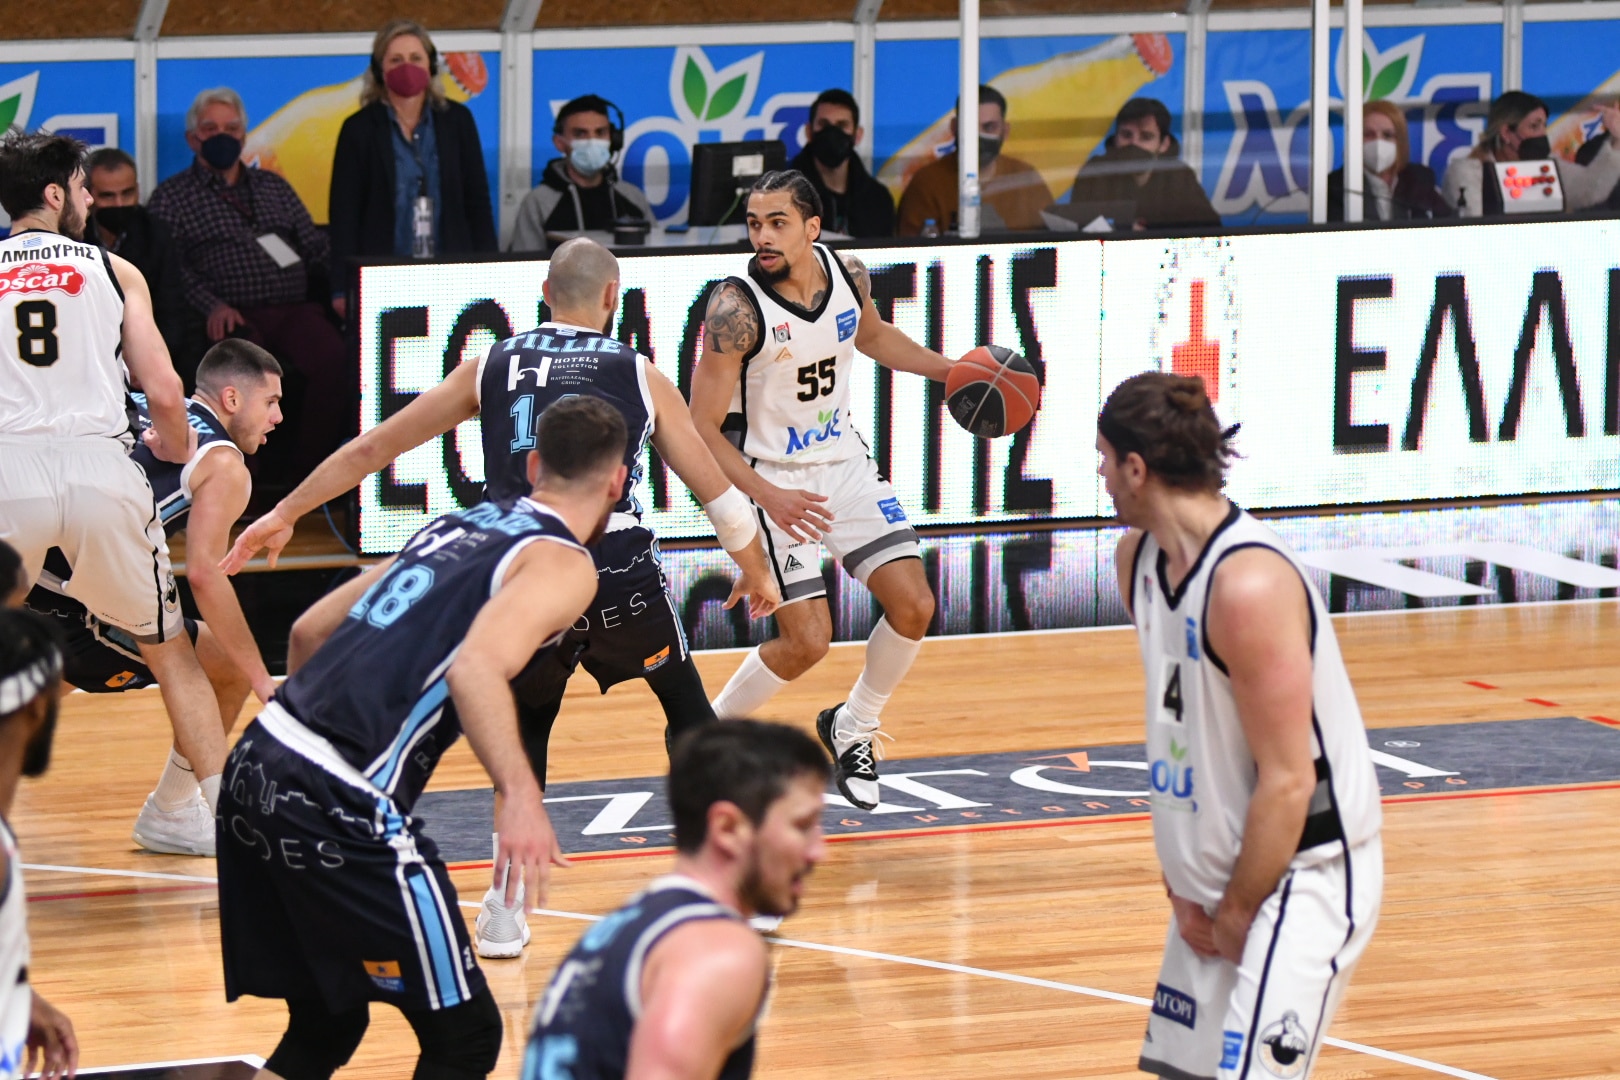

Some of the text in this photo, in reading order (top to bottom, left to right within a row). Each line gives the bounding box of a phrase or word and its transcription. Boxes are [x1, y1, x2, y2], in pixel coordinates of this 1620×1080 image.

[14, 299, 59, 368] 8
[503, 333, 624, 354] TILLIE
[554, 356, 599, 364] HOTELS
[797, 355, 836, 402] 55
[348, 559, 435, 629] 18
[1163, 663, 1183, 722] 4
